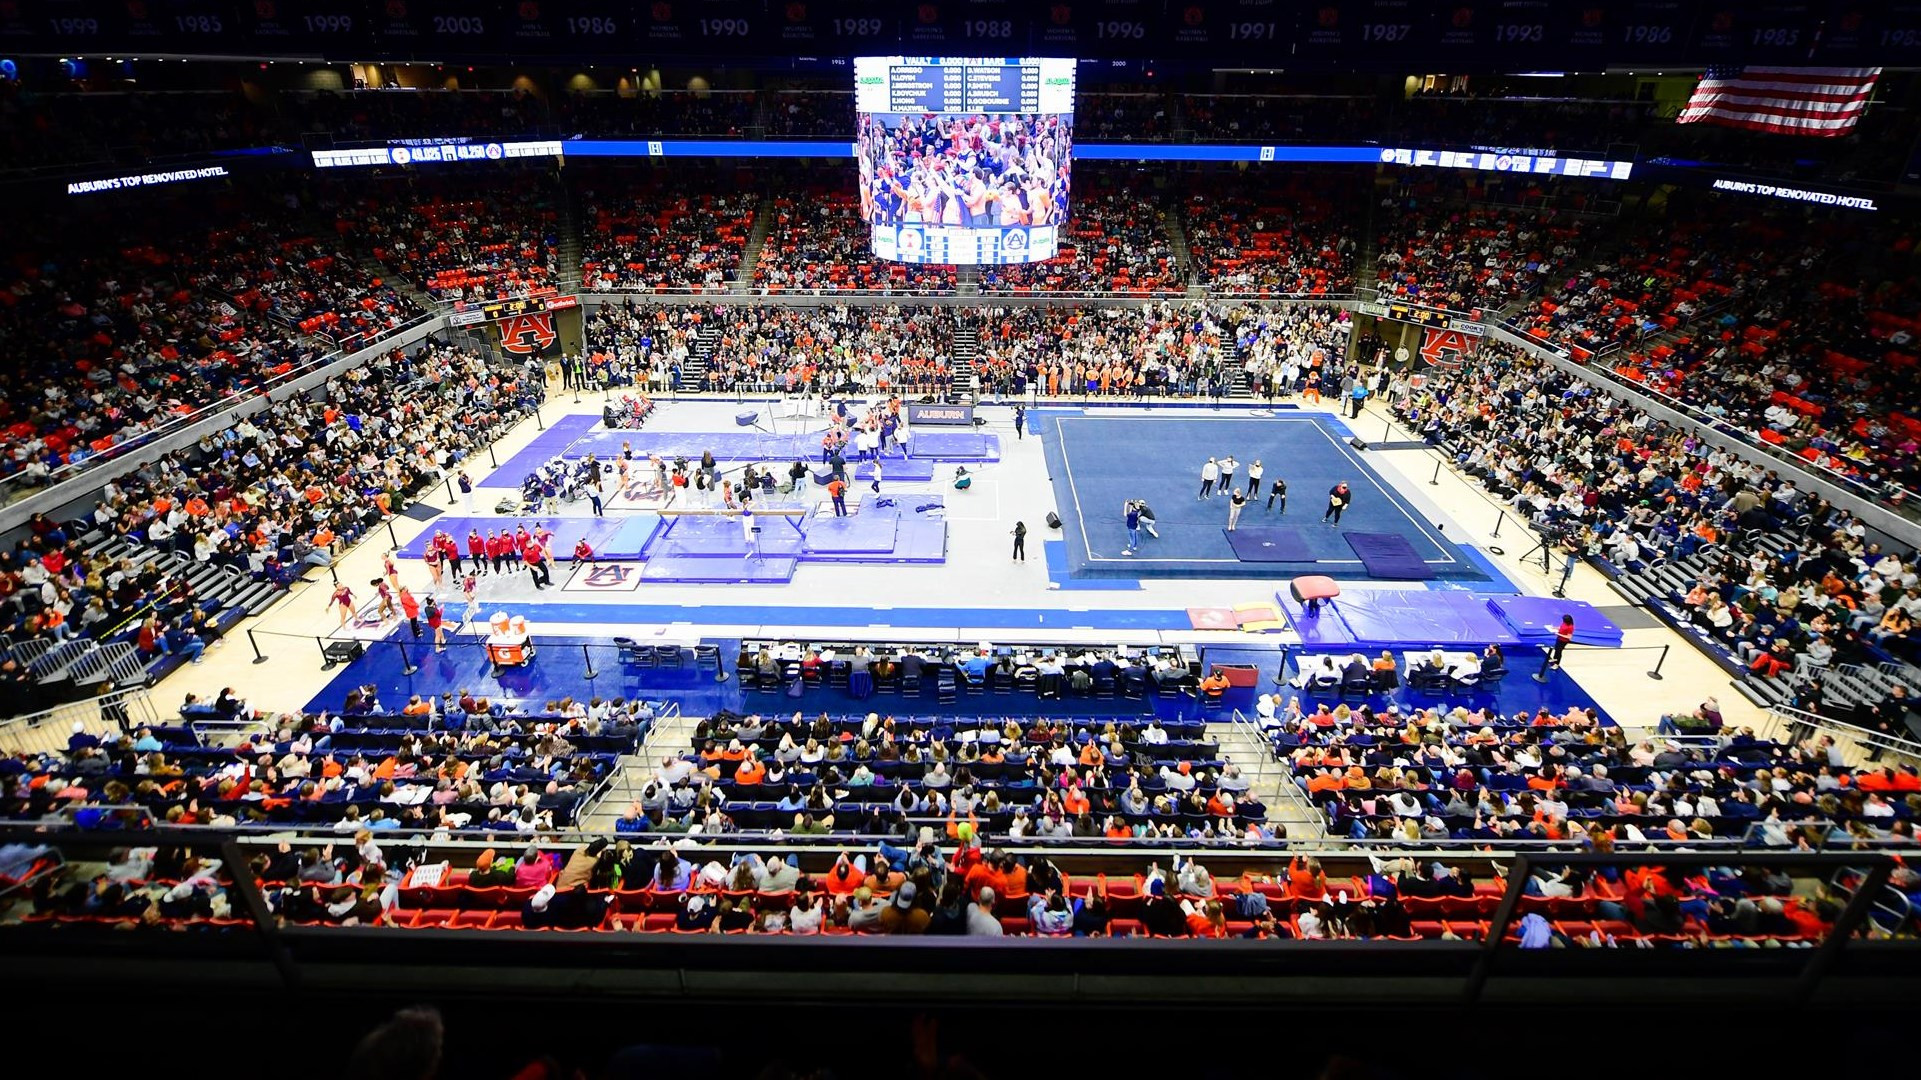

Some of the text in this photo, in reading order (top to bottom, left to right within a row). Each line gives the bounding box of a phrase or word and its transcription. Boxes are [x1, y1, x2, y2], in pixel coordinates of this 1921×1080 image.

[51, 17, 98, 35] 1999
[303, 15, 352, 32] 1999
[433, 16, 484, 34] 2003
[567, 17, 616, 35] 1986
[700, 18, 749, 36] 1990
[833, 18, 882, 36] 1989
[964, 20, 1012, 38] 1988
[1096, 21, 1145, 39] 1996
[1229, 22, 1275, 40] 1991
[1363, 23, 1412, 42] 1987
[1496, 24, 1544, 42] 1993
[1625, 25, 1672, 43] 1986
[905, 57, 932, 65] VAULT
[68, 178, 121, 194] AUBURN'S
[120, 176, 141, 187] TOP
[142, 170, 197, 185] RENOVATED
[1713, 179, 1756, 193] AUBURN'S
[1757, 185, 1776, 196] TOP
[1775, 187, 1836, 204] RENOVATED
[510, 301, 525, 310] 2:00
[1414, 310, 1429, 320] 2:00
[231, 411, 240, 421] M
[917, 410, 965, 419] AUBURN
